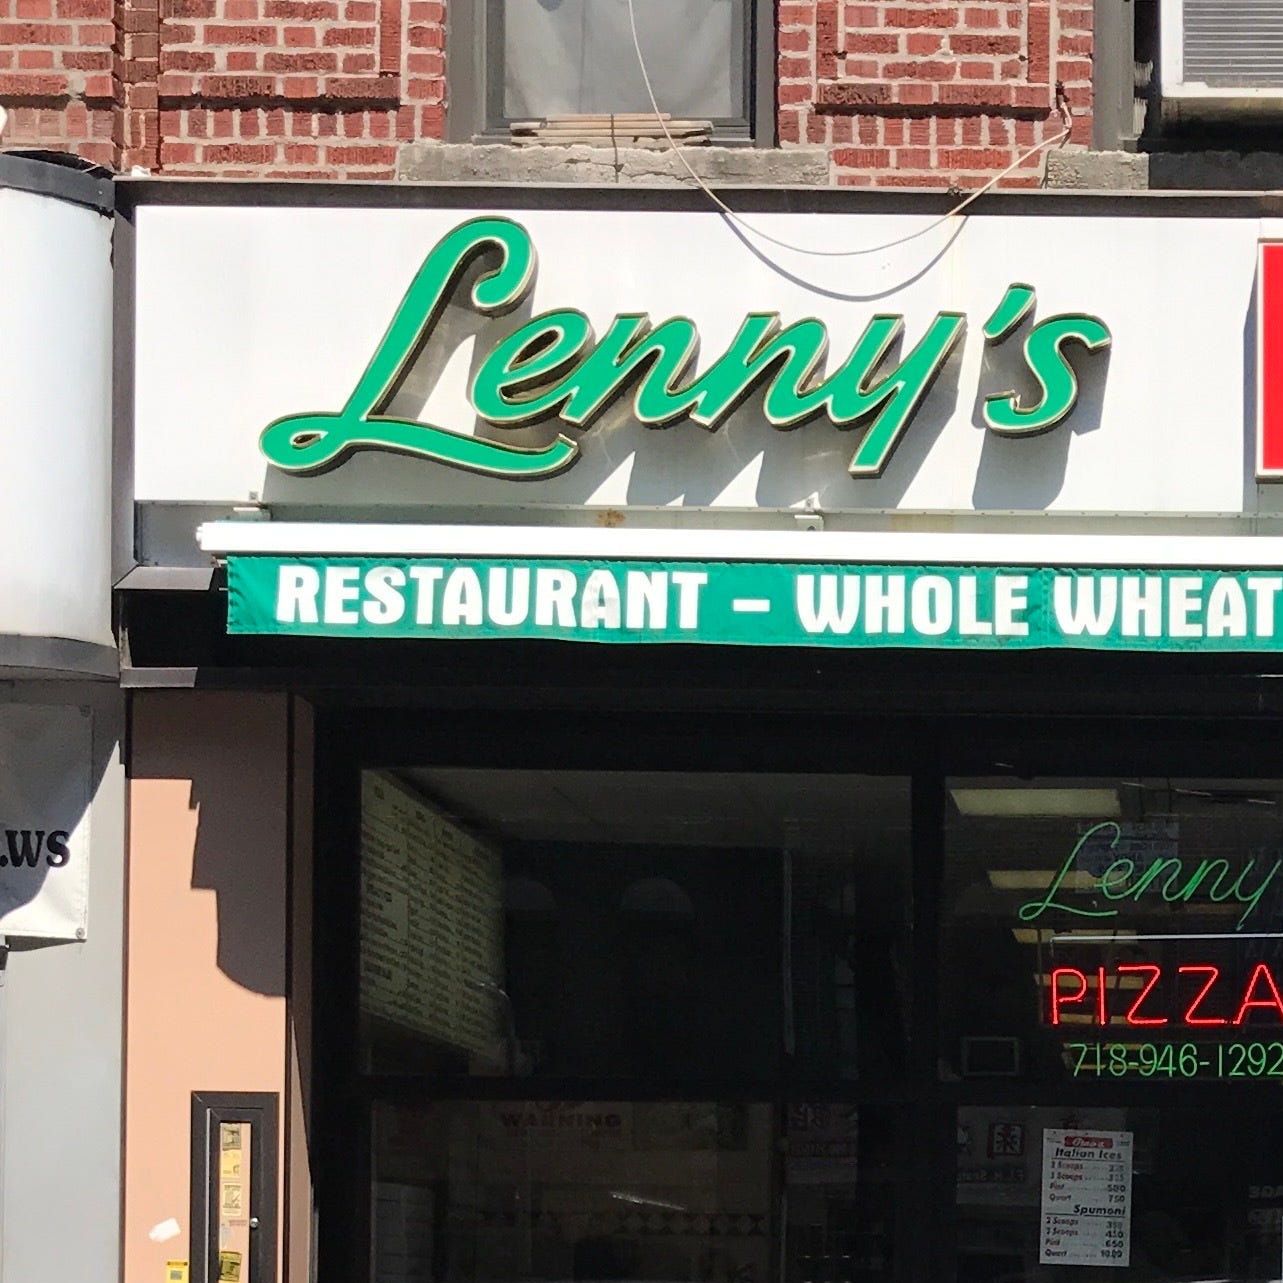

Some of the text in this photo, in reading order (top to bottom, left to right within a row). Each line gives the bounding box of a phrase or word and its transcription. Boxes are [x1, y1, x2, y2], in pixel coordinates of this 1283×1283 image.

[257, 216, 1112, 480] Lenny's
[275, 565, 708, 630] RESTAURANT
[796, 574, 1029, 636] WHOLE
[1053, 576, 1283, 637] WHEAT
[1055, 1147, 1122, 1160] Italian Ices
[1073, 1204, 1126, 1216] Spumoni
